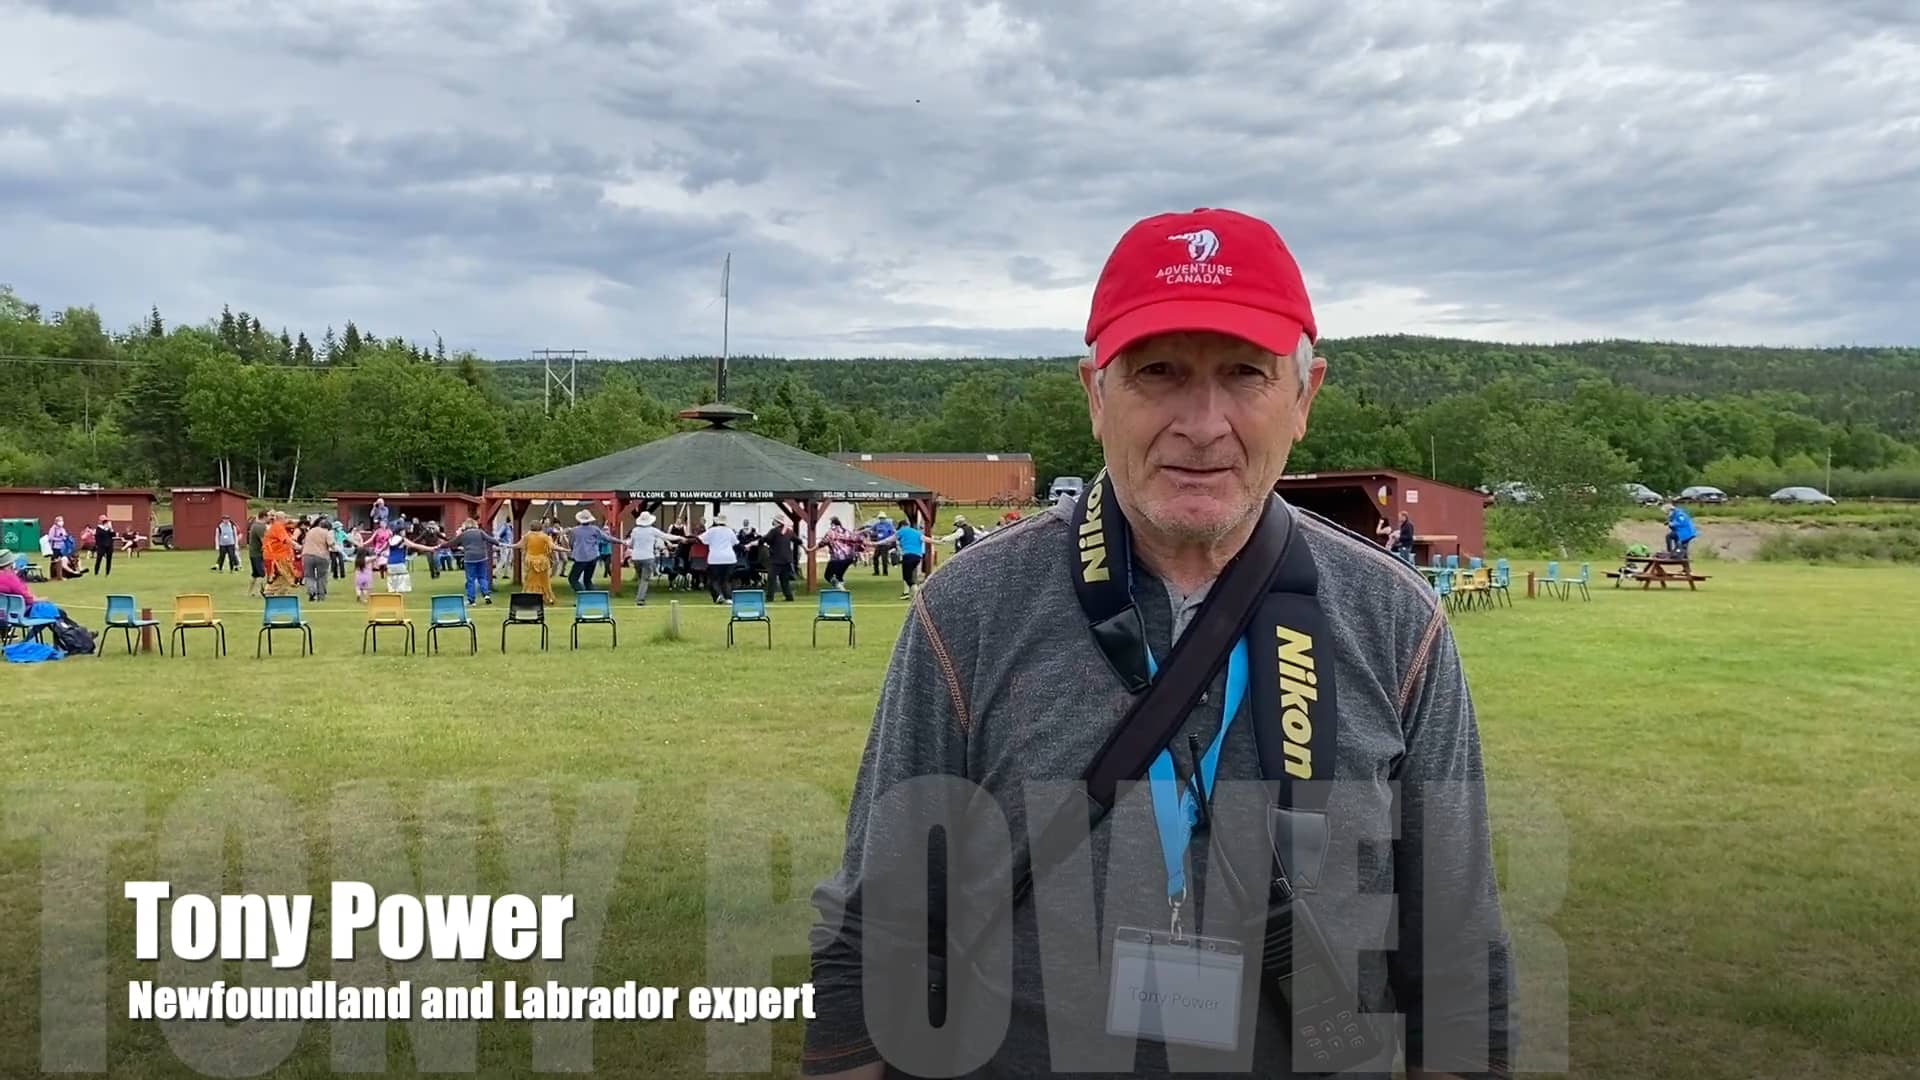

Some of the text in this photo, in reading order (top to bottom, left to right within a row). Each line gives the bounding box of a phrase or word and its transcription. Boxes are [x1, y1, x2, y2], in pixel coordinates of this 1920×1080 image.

[1155, 263, 1233, 278] ADVENTURE
[1166, 274, 1222, 285] CANADA
[629, 490, 665, 499] WELCOME
[669, 490, 678, 499] TO
[724, 490, 746, 499] FIRST
[748, 490, 774, 499] NATION
[1276, 625, 1319, 780] Nikon
[1128, 985, 1219, 1009] Tony Power
